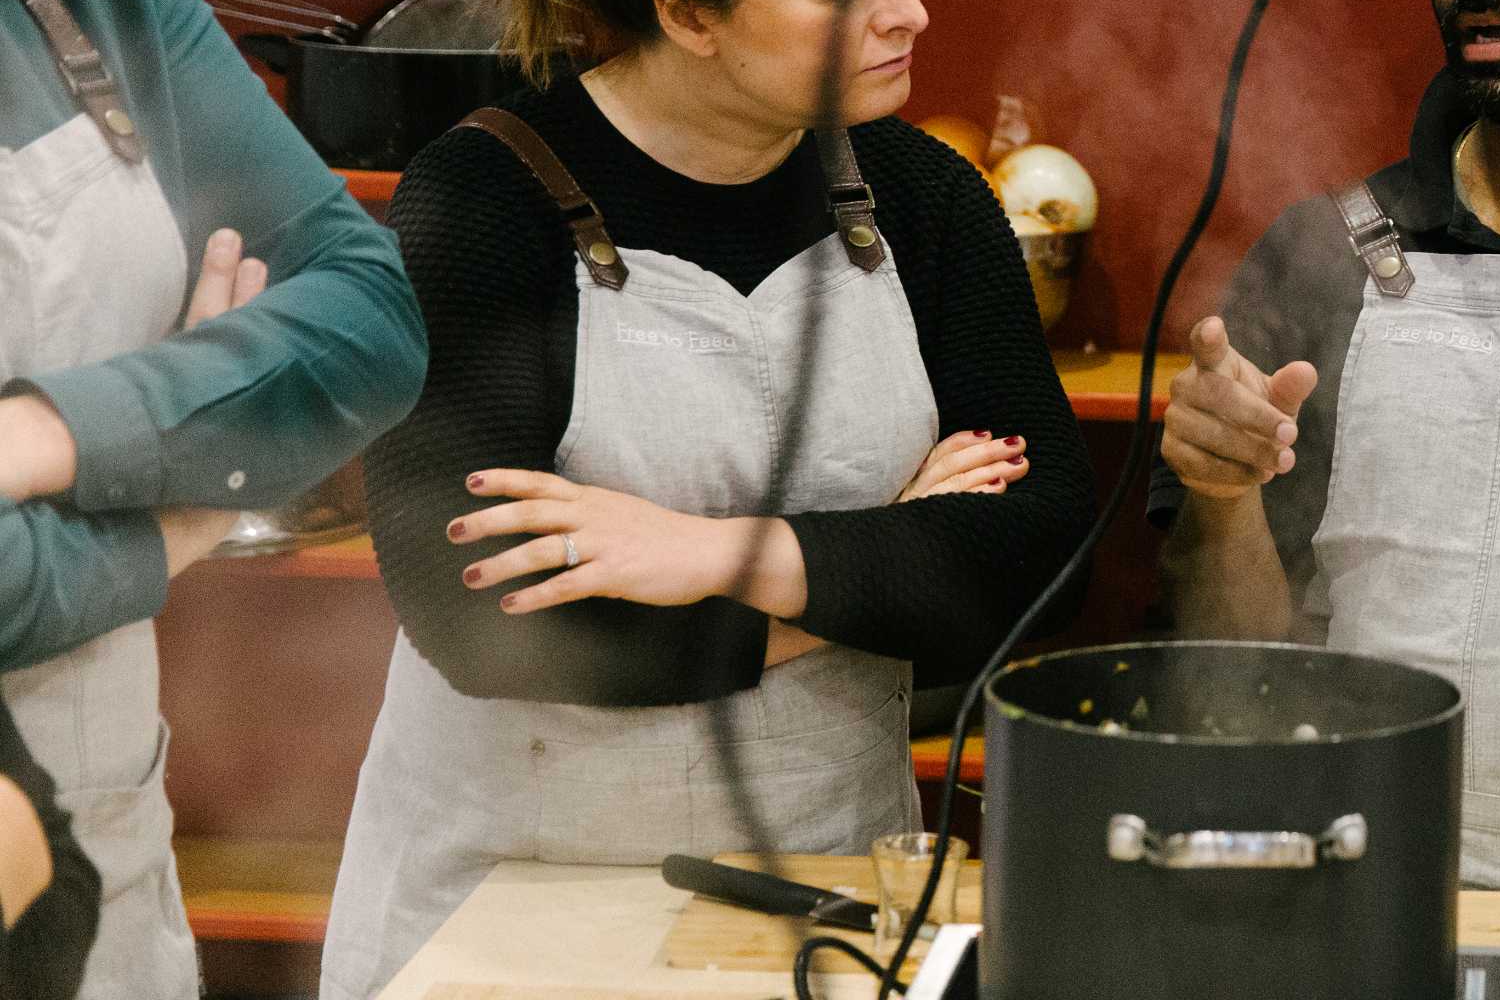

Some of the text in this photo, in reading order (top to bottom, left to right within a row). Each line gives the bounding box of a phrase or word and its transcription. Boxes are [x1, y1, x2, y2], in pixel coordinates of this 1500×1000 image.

[616, 321, 659, 343] Free
[1384, 321, 1494, 351] Free to Feed
